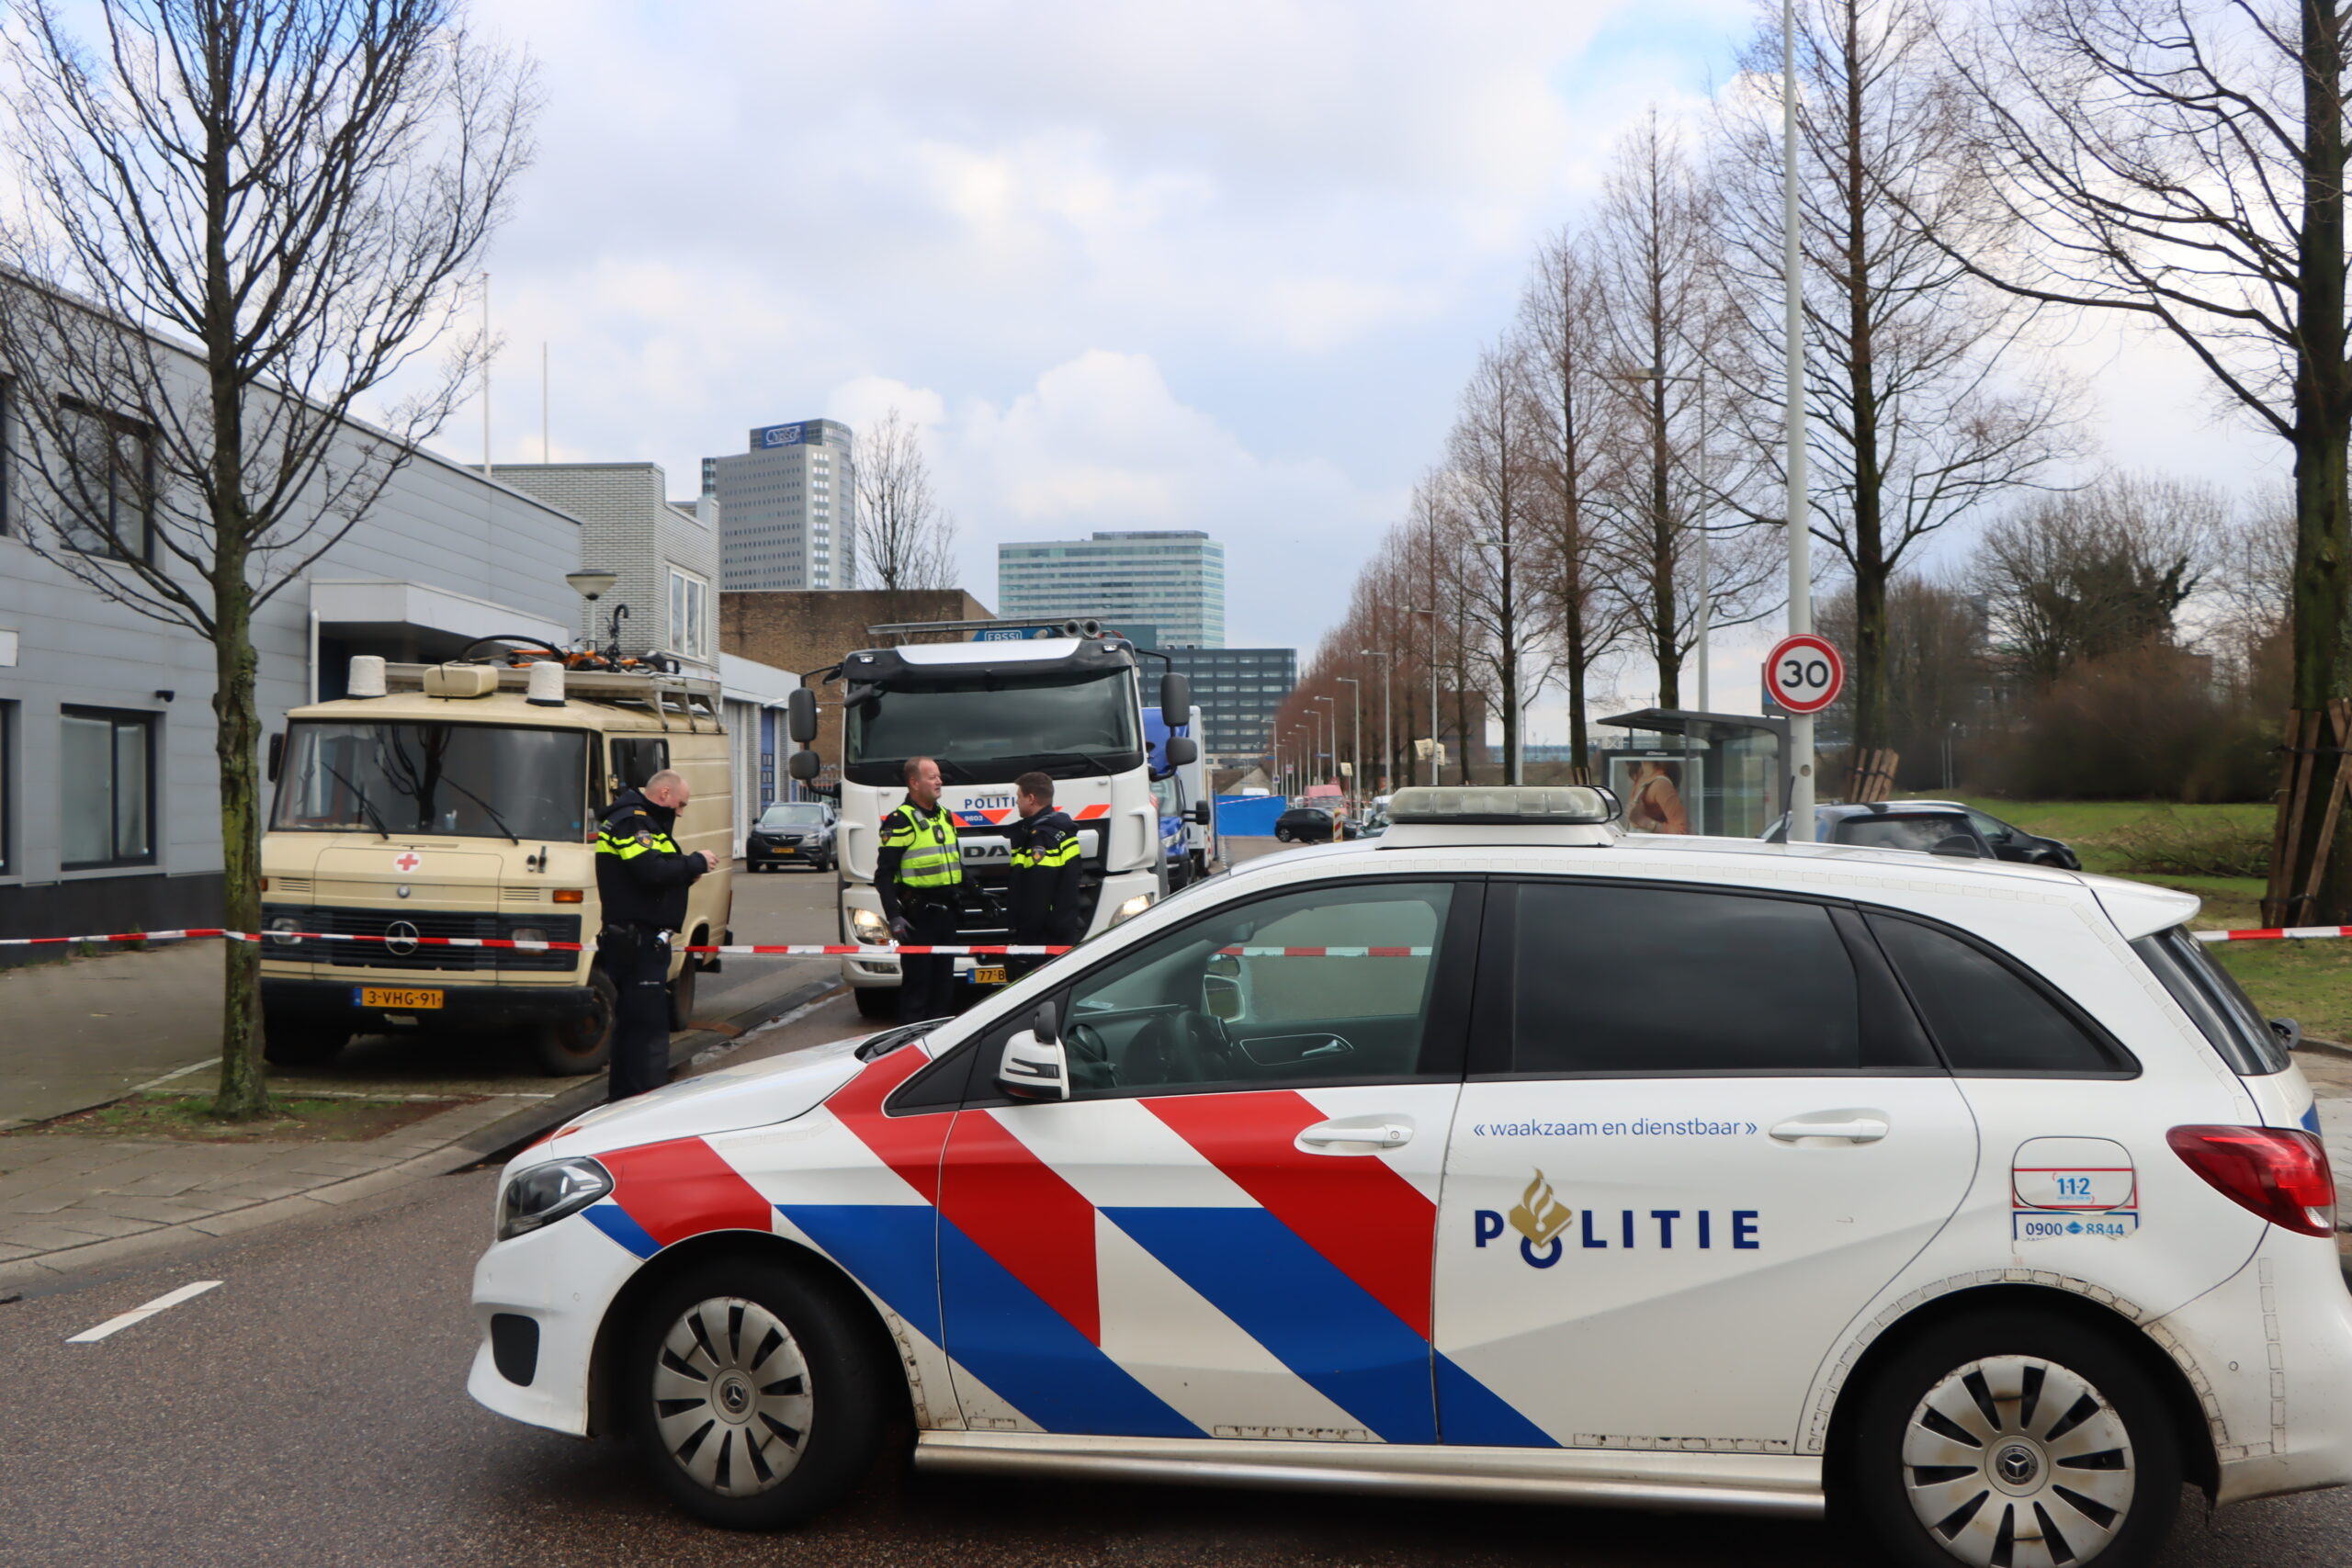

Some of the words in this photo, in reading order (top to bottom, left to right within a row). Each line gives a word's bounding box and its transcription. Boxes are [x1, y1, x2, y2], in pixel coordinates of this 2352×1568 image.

[988, 632, 1019, 641] FASSI
[1781, 660, 1828, 688] 30
[965, 796, 1015, 809] POLITI
[963, 845, 1010, 858] DA
[368, 990, 435, 1006] 3-VHG-91
[1489, 1119, 1597, 1136] waakzaam
[1602, 1122, 1626, 1135] en
[1632, 1118, 1740, 1135] dienstbaar
[2025, 1223, 2063, 1235] 0900
[2086, 1223, 2124, 1235] 8844
[1475, 1209, 1759, 1269] POLITIE
